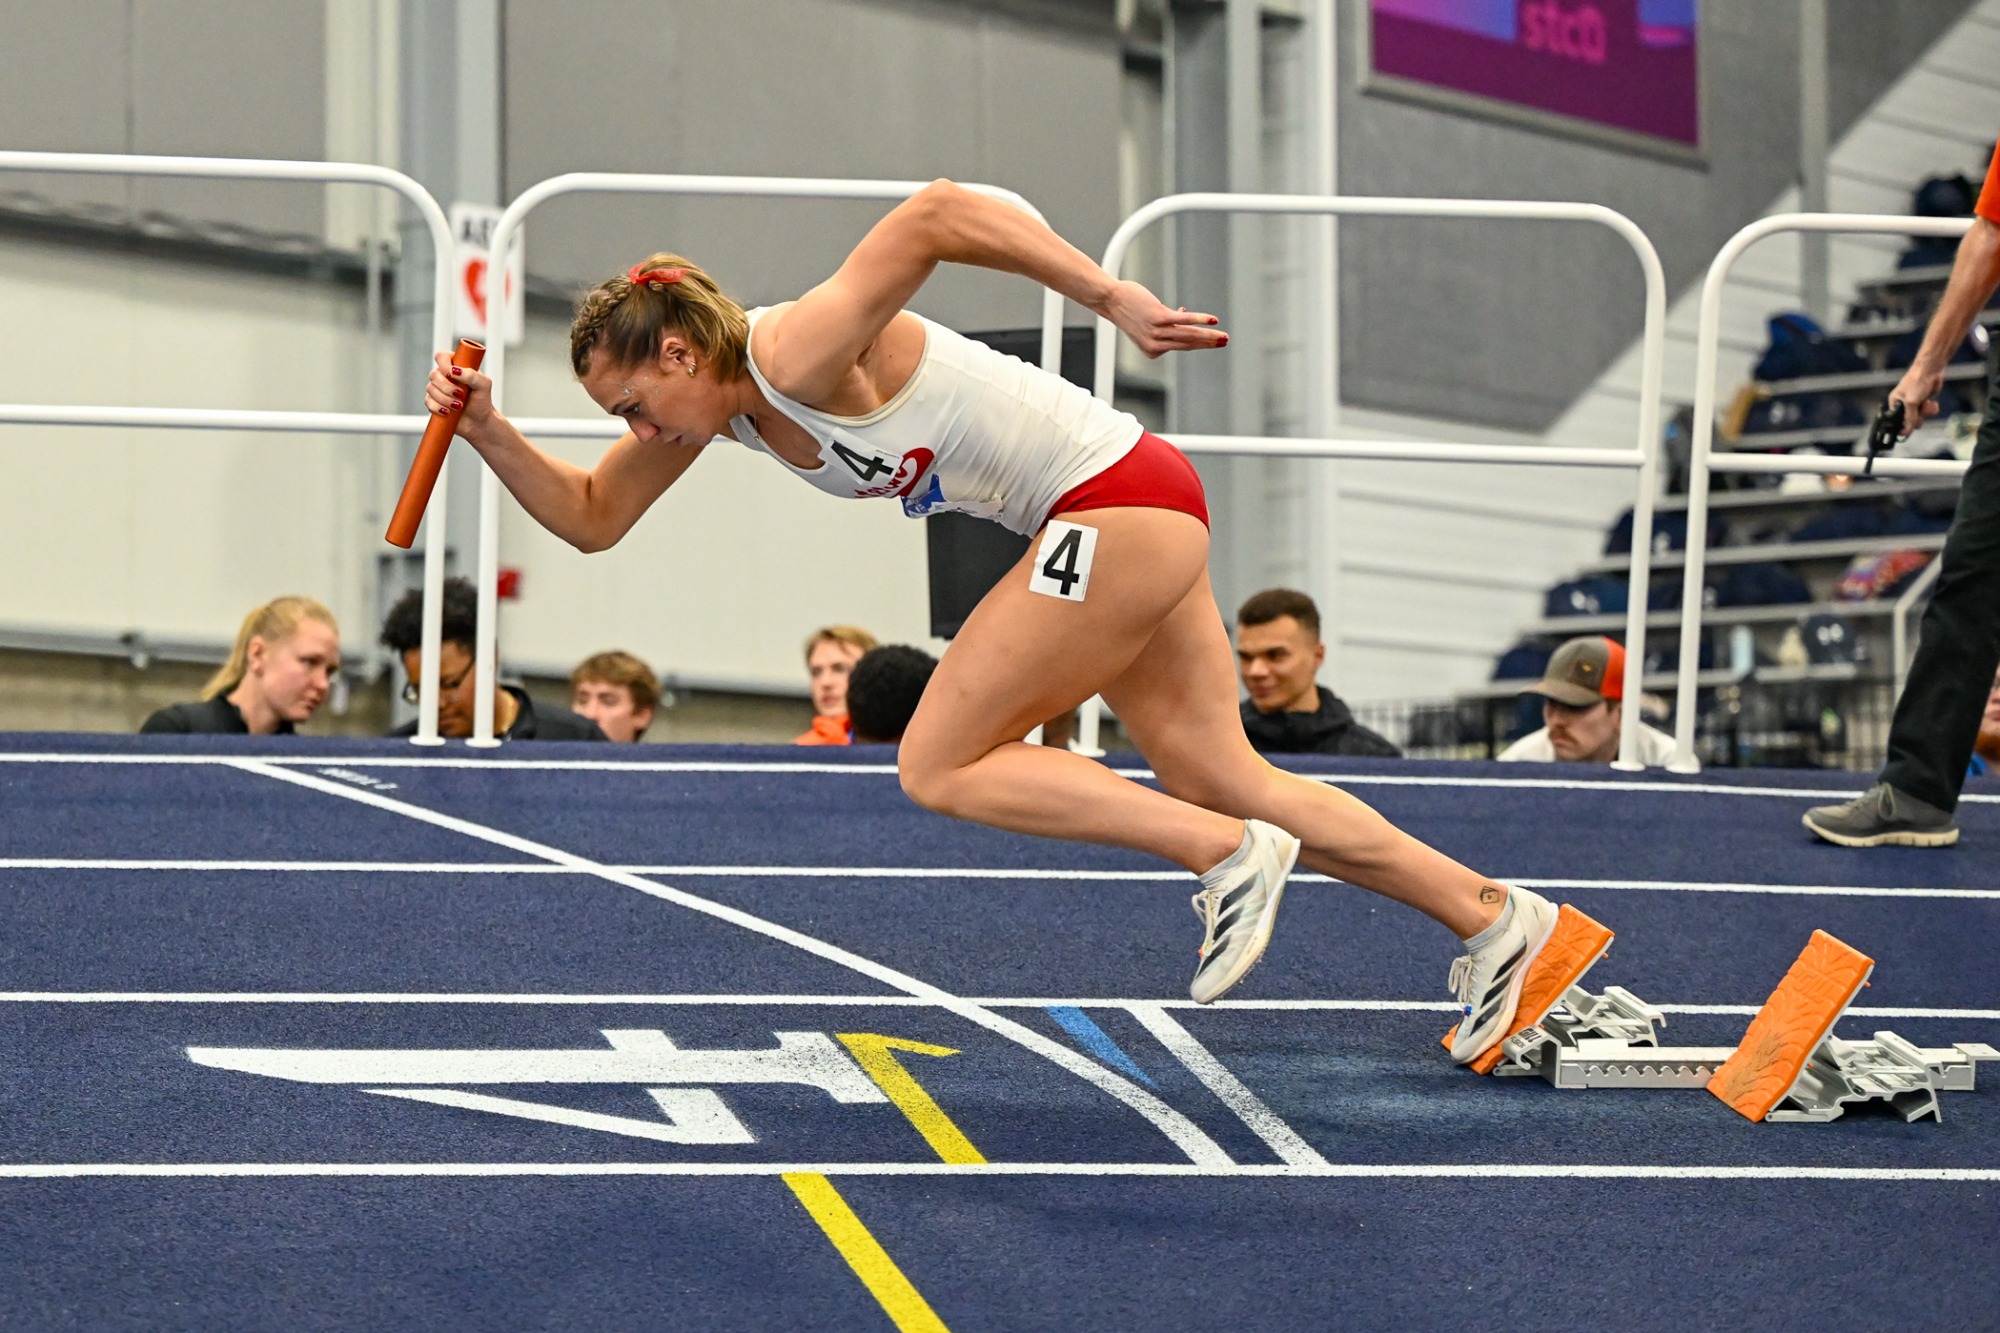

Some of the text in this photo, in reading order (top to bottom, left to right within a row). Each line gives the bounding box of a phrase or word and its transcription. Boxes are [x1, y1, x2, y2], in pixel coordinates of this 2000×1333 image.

[830, 440, 895, 482] 4
[1043, 529, 1083, 596] 4
[186, 1029, 889, 1144] 4
